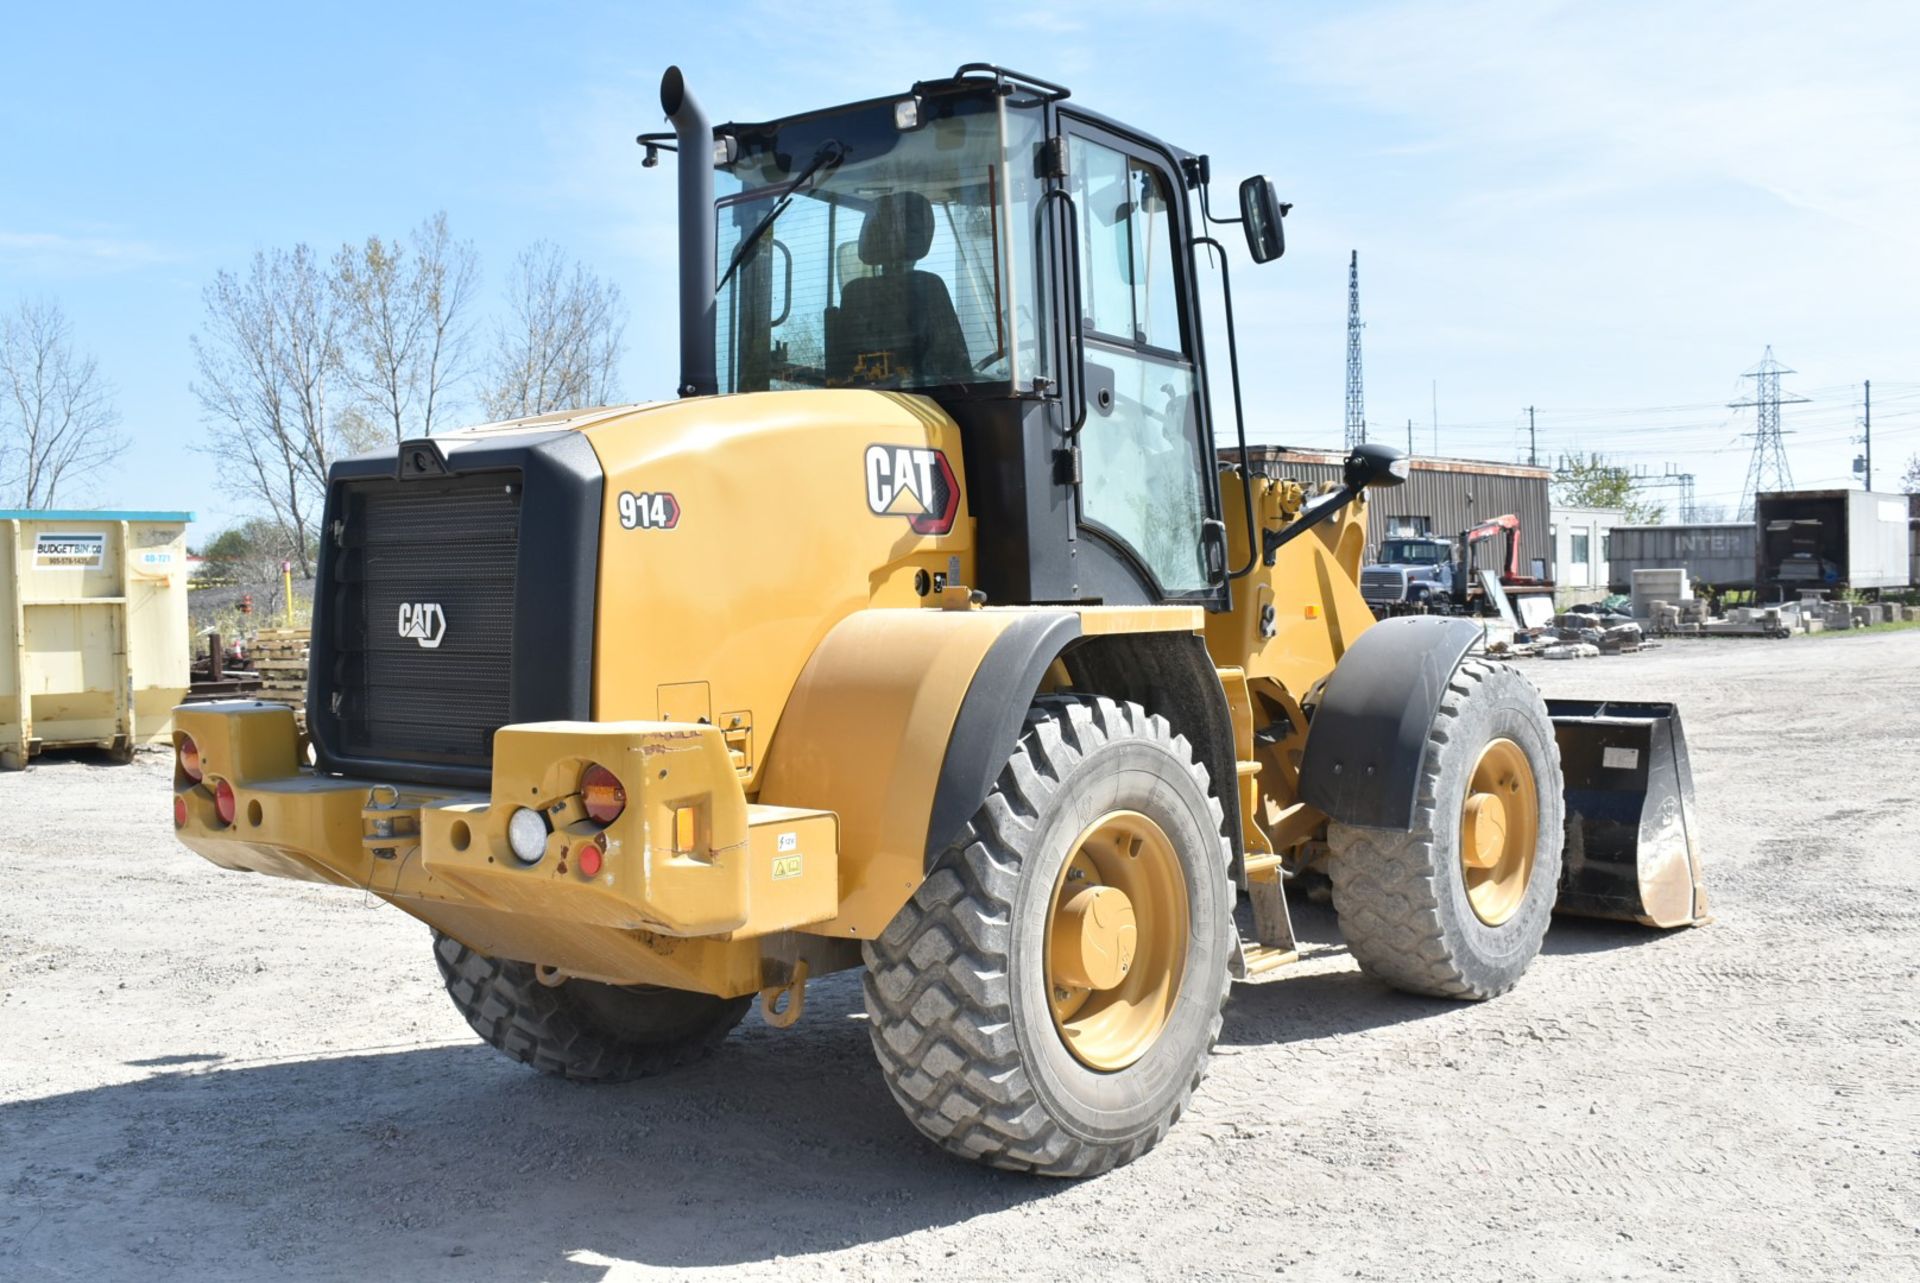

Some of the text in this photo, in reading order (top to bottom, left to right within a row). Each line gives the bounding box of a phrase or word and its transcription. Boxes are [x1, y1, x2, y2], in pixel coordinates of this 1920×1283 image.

[866, 446, 936, 514] CAT
[619, 491, 666, 528] 914
[1674, 535, 1740, 551] INTER
[399, 602, 436, 638] CAT
